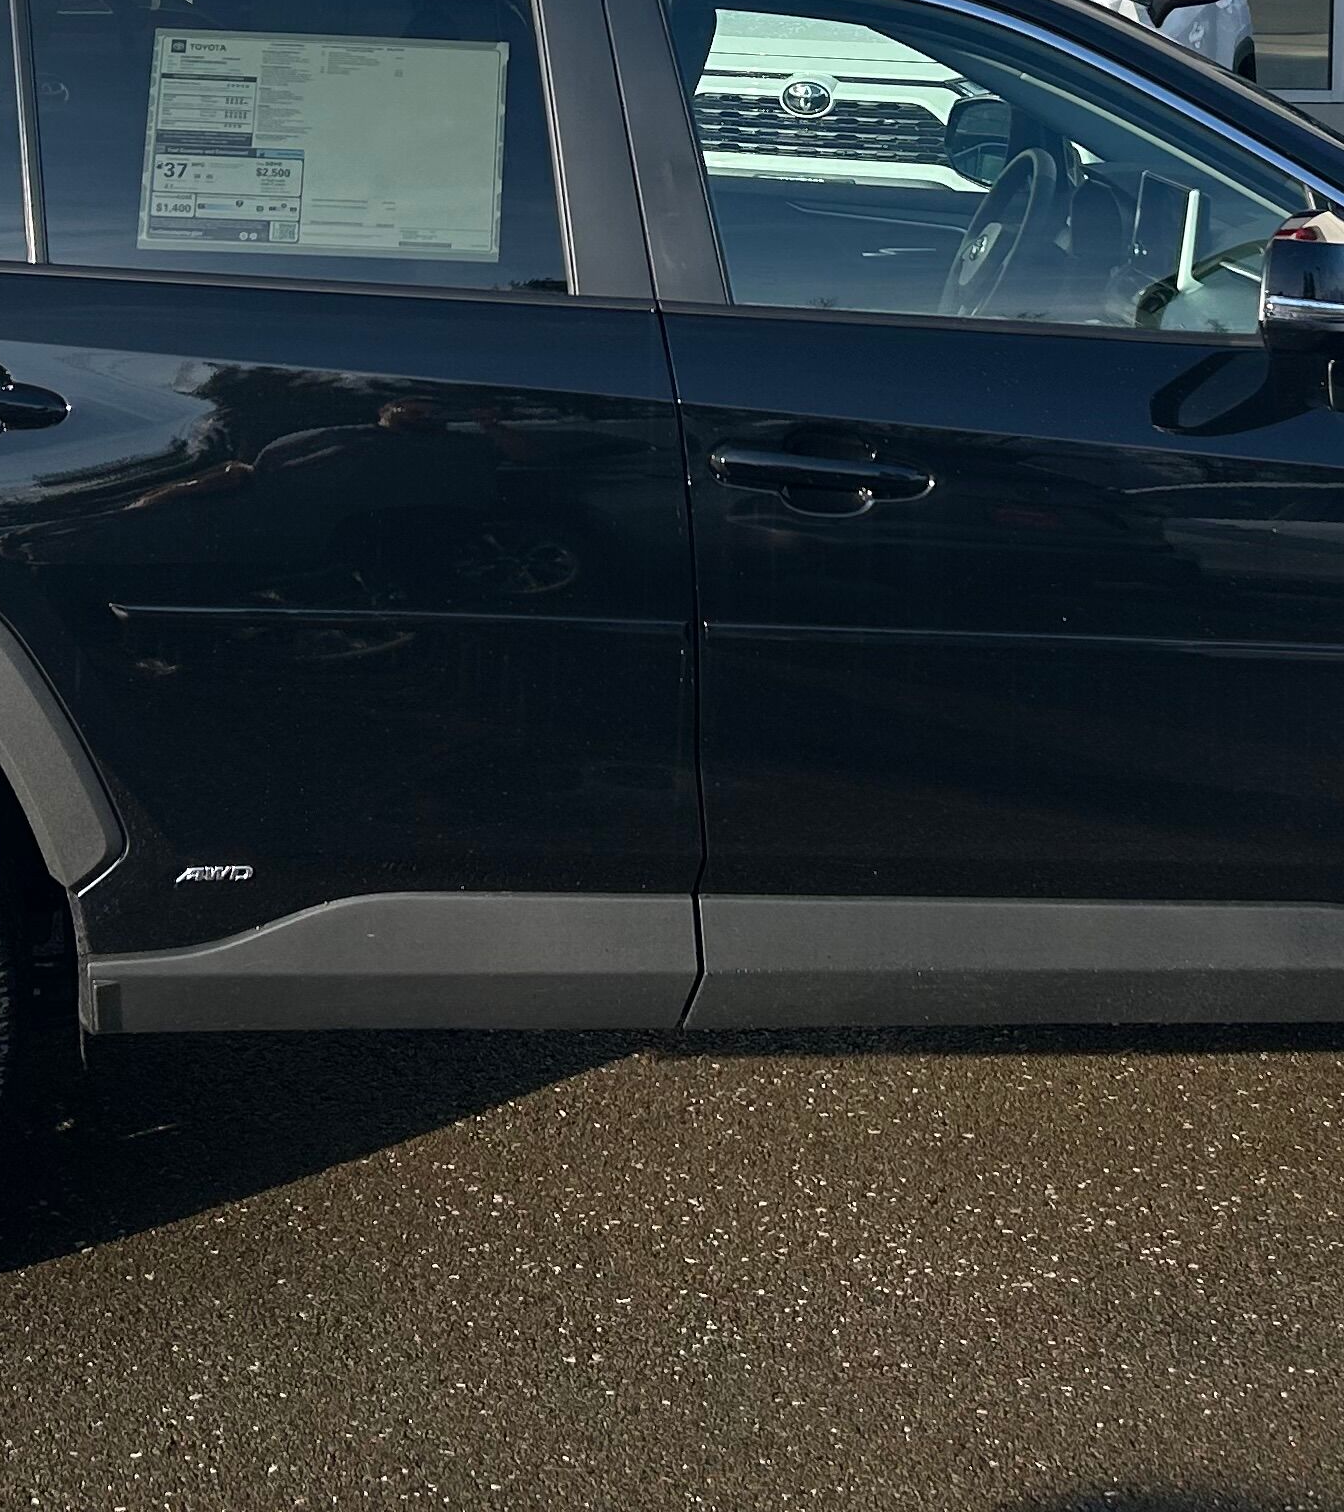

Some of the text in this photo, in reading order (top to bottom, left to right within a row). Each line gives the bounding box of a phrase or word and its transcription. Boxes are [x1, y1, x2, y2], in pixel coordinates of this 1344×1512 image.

[190, 42, 227, 52] TOYOTA
[163, 162, 188, 178] 37
[175, 865, 254, 884] AWD
